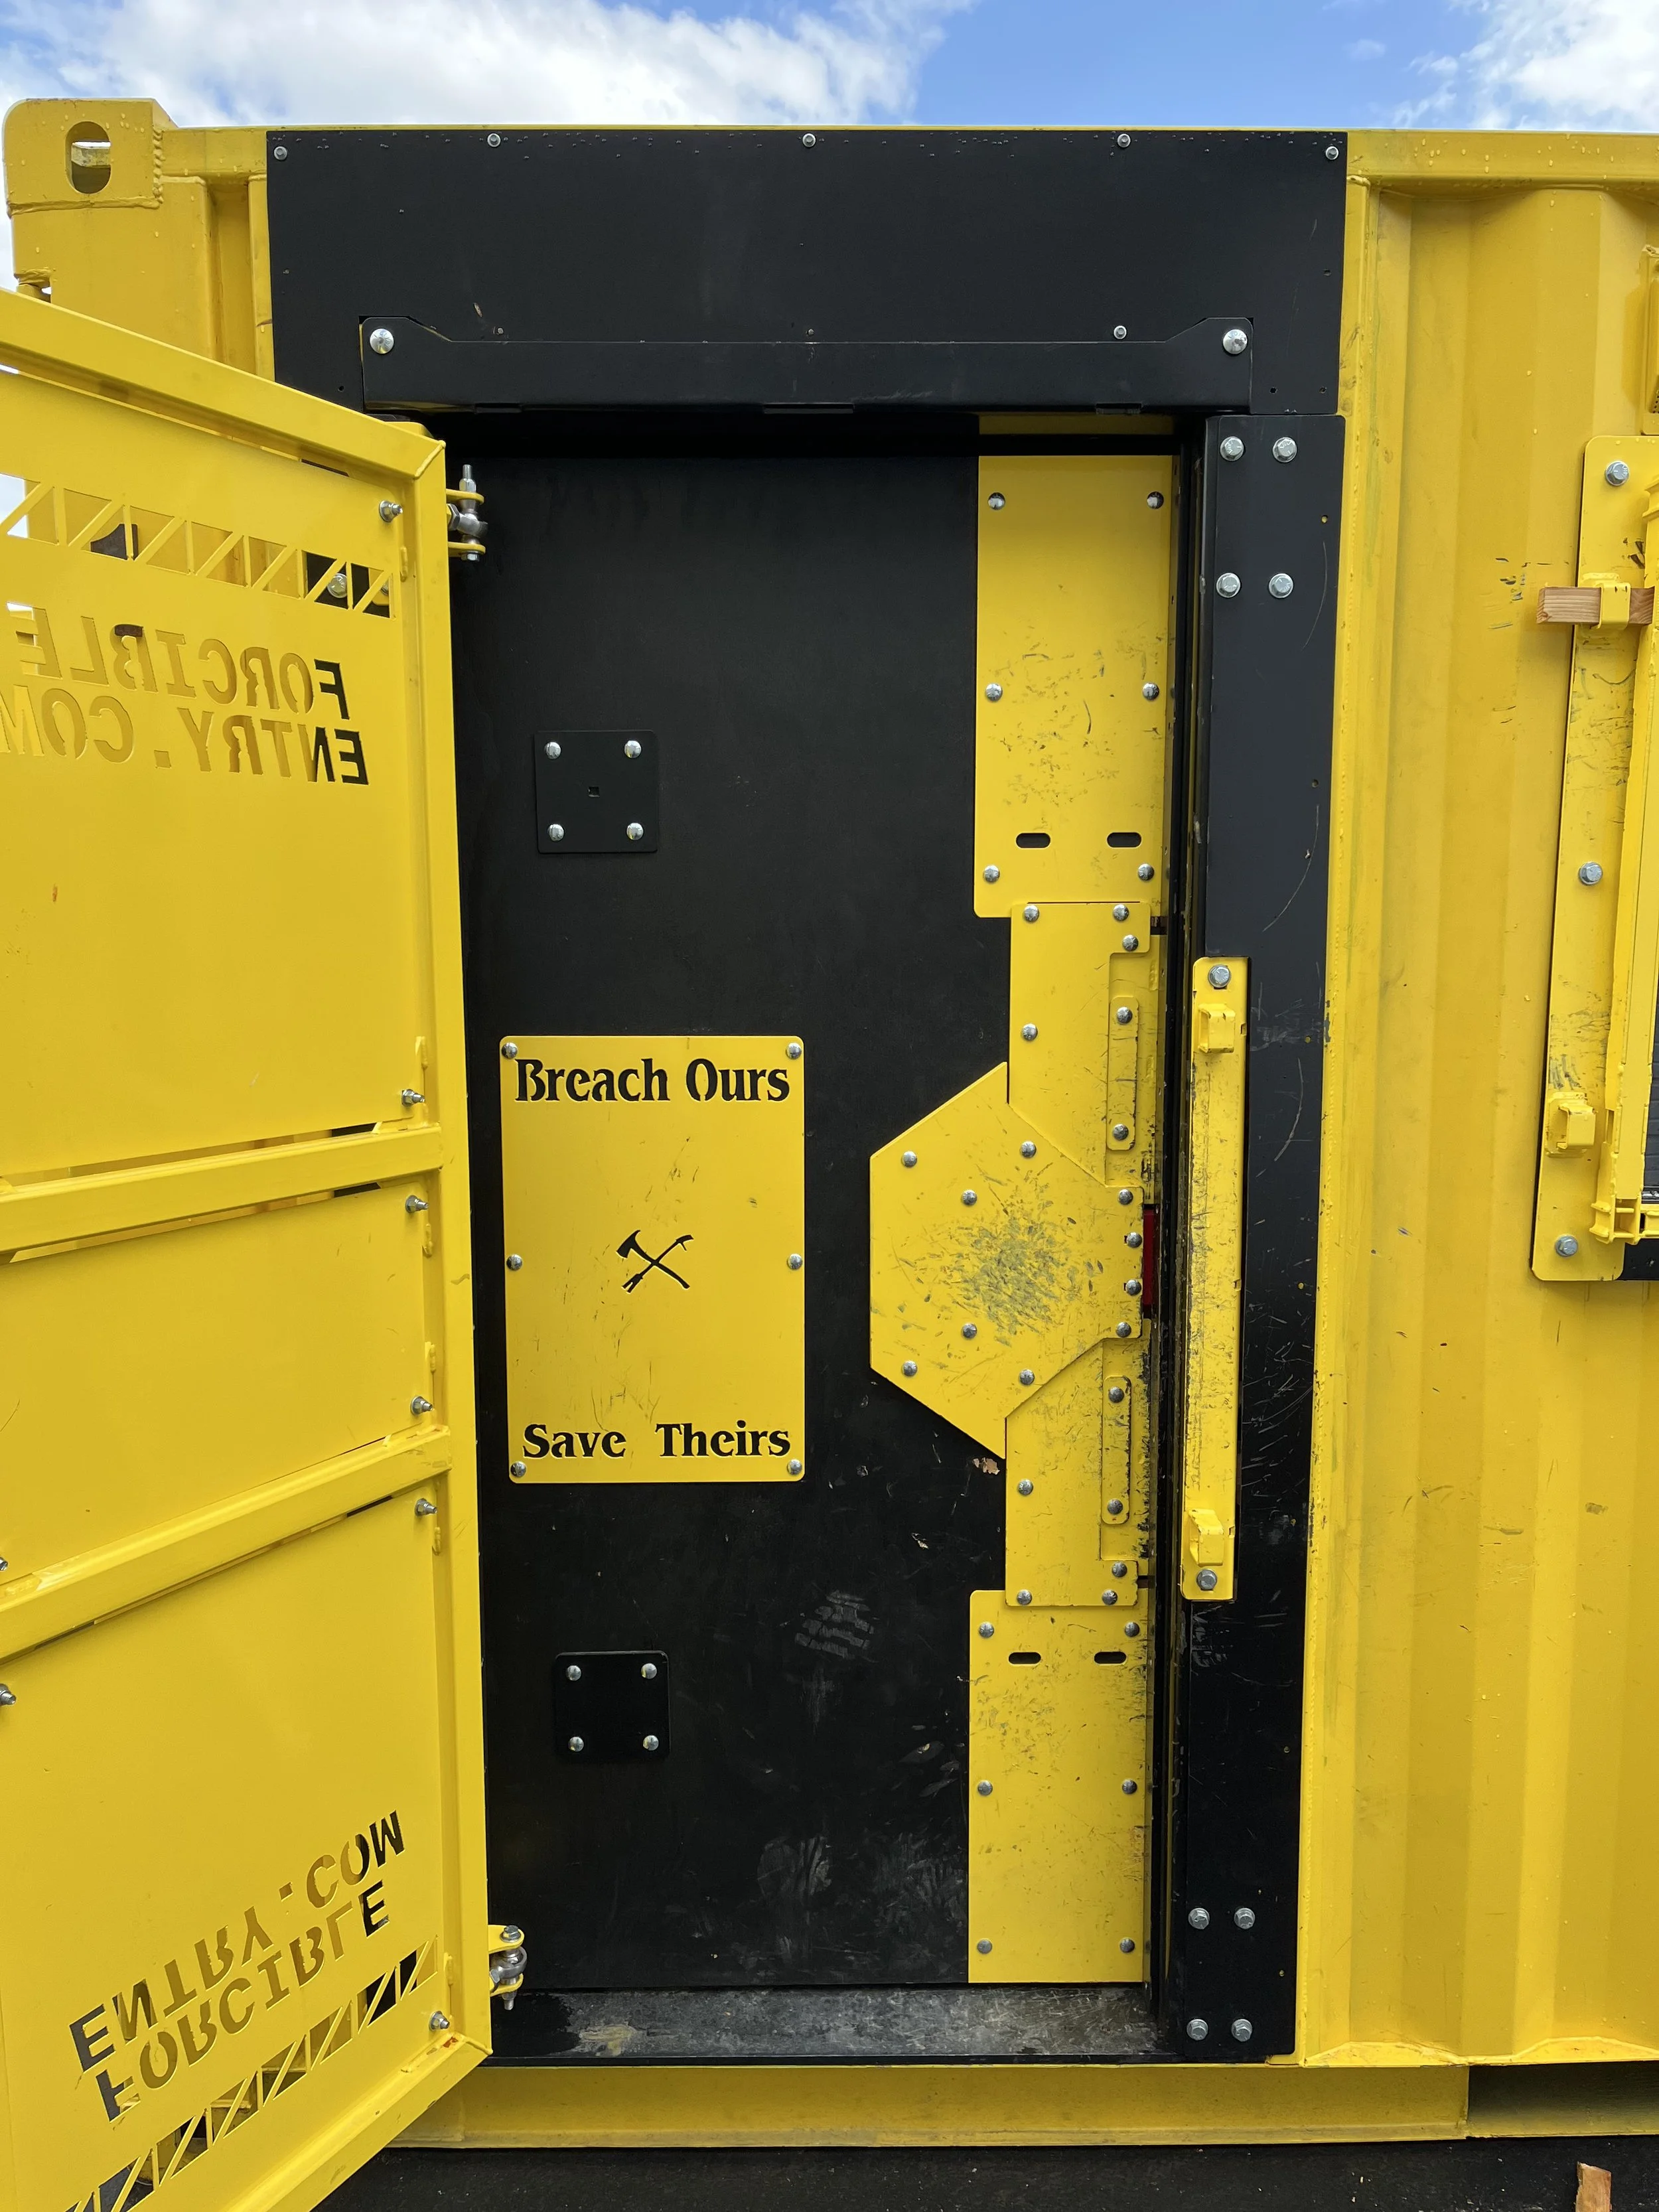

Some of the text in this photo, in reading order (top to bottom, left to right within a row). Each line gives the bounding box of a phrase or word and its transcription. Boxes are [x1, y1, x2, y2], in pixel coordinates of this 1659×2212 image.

[516, 1059, 790, 1102] Breach Ours
[523, 1420, 791, 1457] Save Theirs
